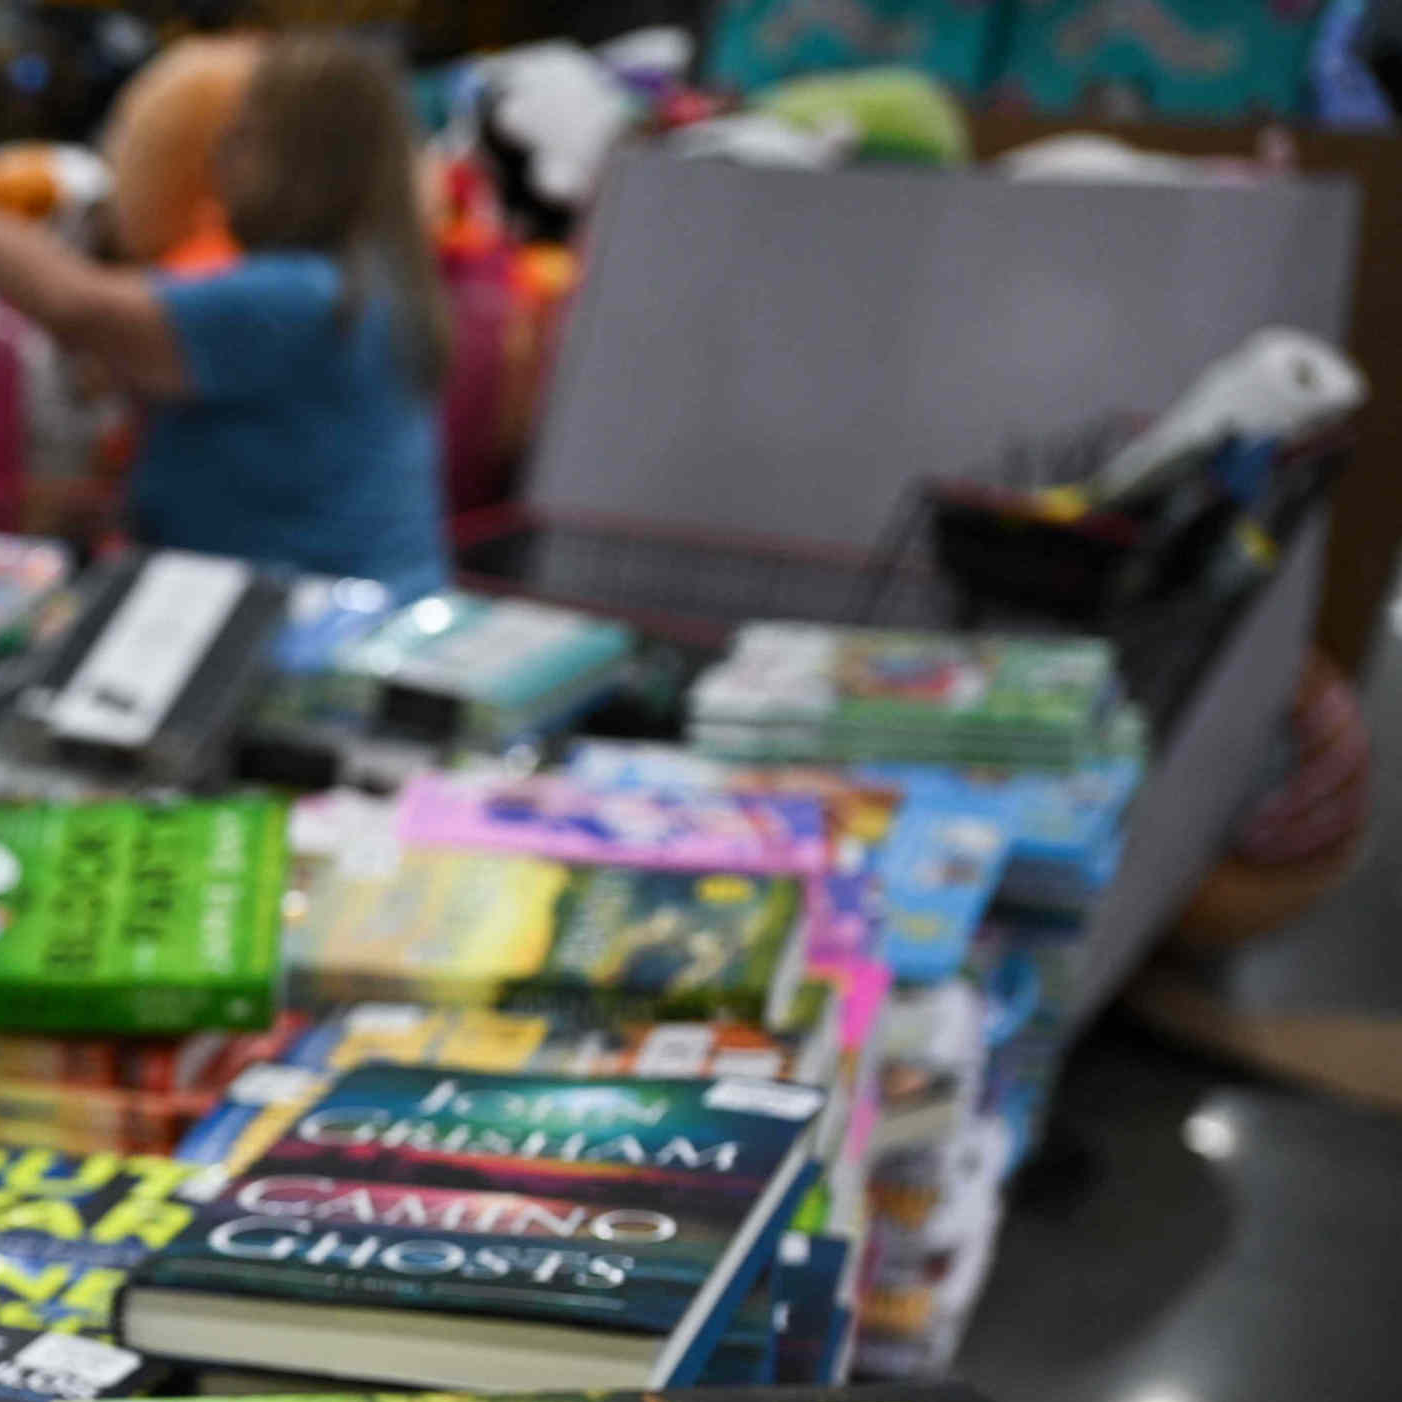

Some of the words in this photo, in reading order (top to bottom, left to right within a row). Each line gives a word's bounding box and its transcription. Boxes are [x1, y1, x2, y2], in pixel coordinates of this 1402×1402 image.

[297, 1105, 742, 1173] GRISHAM
[233, 1174, 679, 1244] CAMINO
[205, 1214, 637, 1291] GHOSTS
